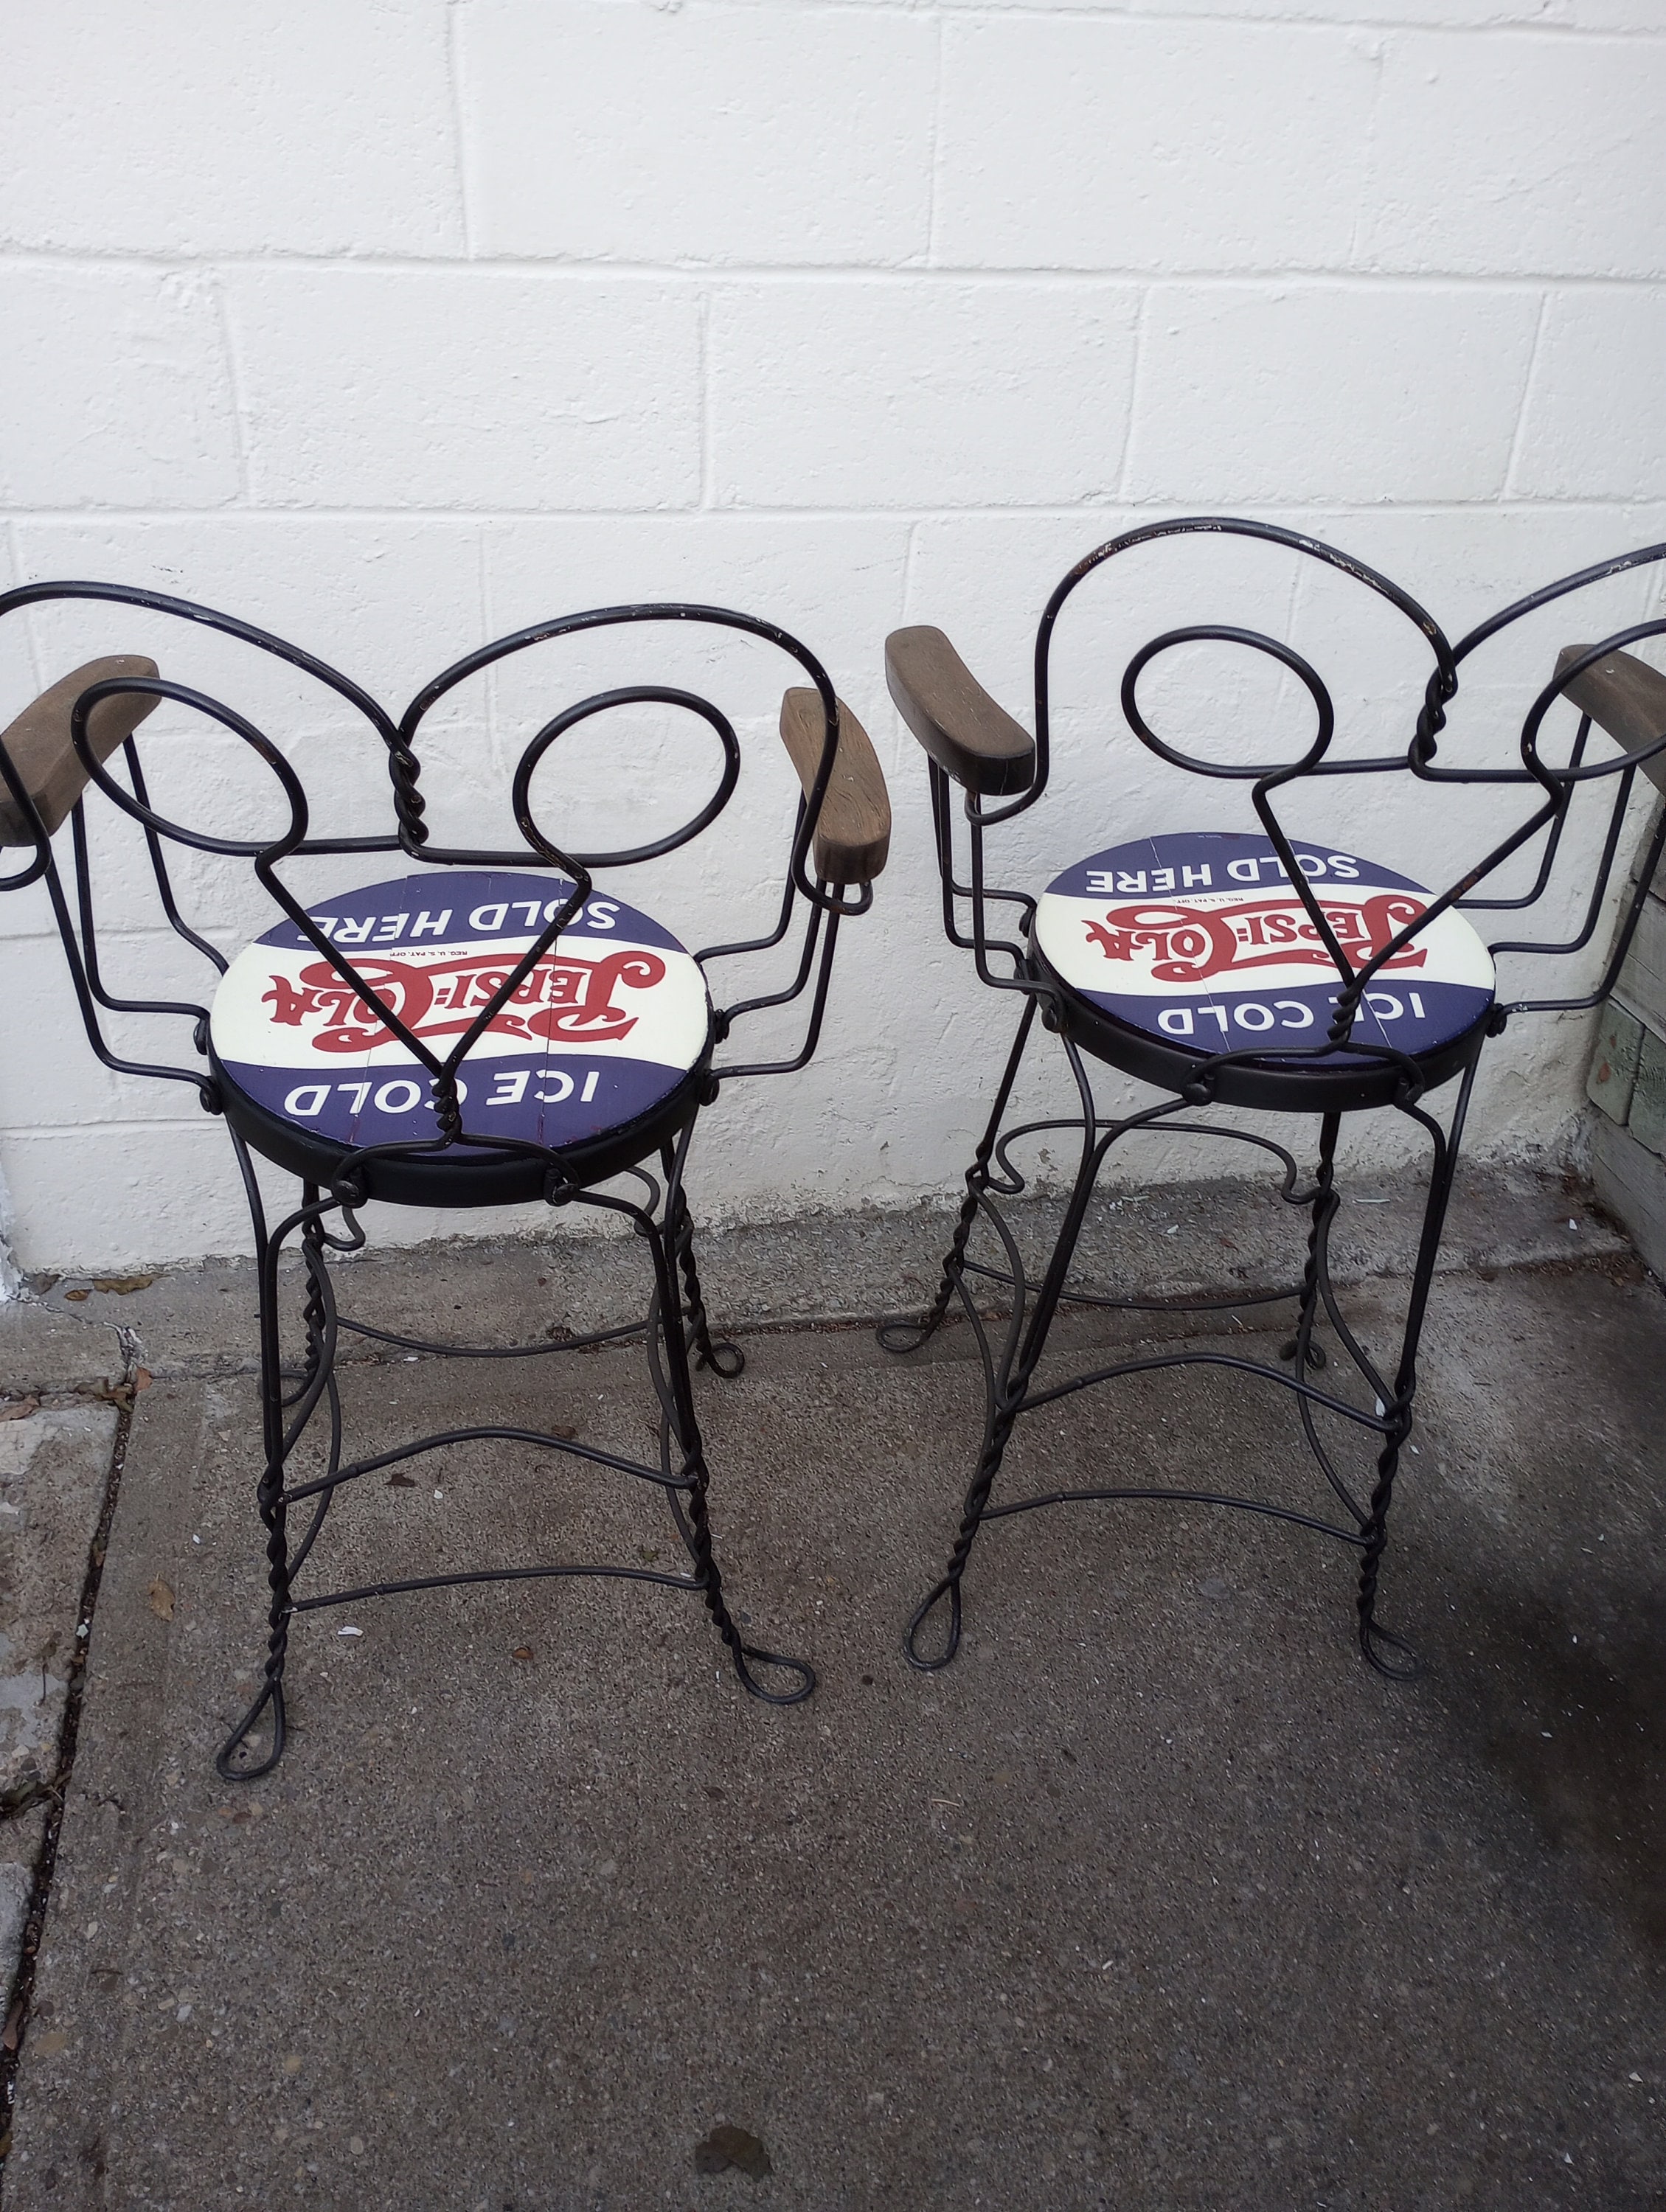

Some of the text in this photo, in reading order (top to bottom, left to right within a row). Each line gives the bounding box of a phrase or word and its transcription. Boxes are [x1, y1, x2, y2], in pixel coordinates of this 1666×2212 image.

[1086, 854, 1360, 893] SOLD HERE
[296, 898, 620, 943] SOLD HERE
[1157, 1000, 1314, 1034] COLD
[485, 1069, 600, 1106] ICE
